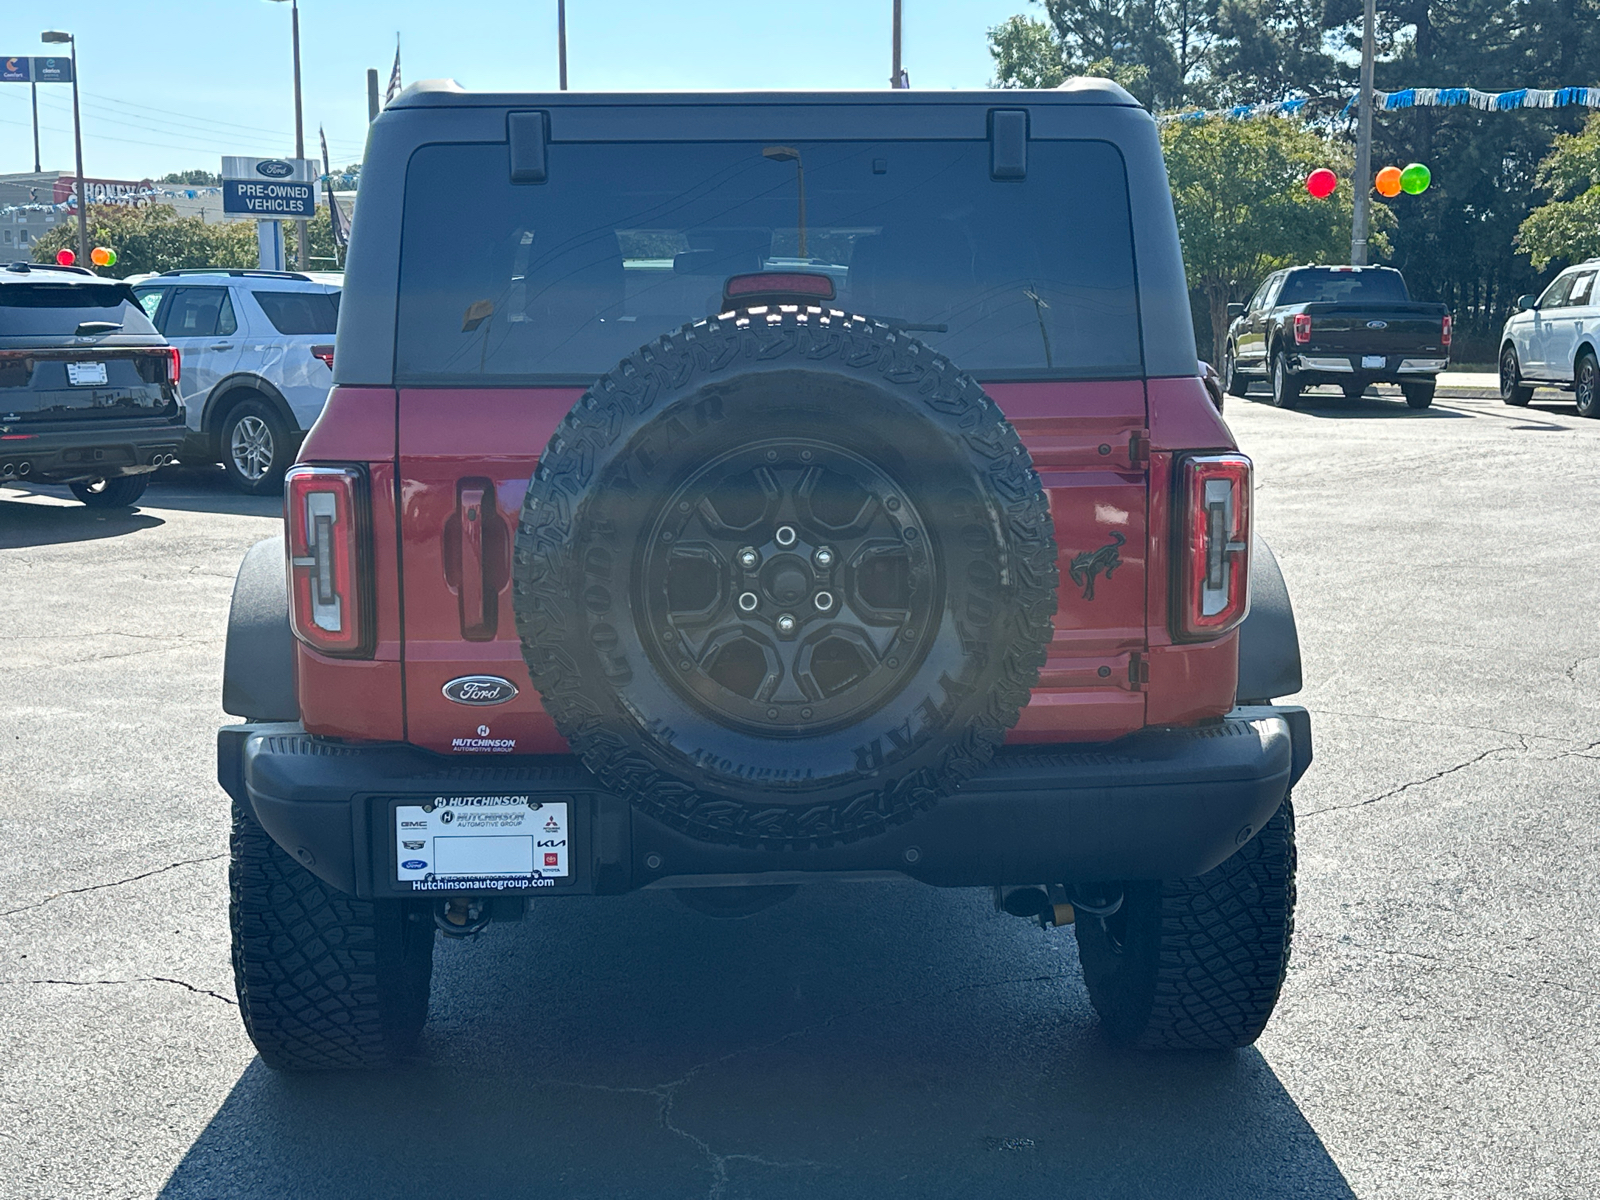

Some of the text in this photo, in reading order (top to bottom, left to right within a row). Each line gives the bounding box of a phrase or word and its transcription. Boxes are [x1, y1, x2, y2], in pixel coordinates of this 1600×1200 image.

[266, 164, 287, 175] Ford
[238, 184, 309, 199] PRE-OWNED
[245, 198, 304, 212] VEHICLES
[460, 682, 500, 699] Ford
[451, 738, 516, 747] HUTCHINSON
[448, 796, 529, 807] HUTCHINSON
[457, 812, 526, 821] HUTCHINSON
[537, 839, 566, 847] KIA
[405, 861, 423, 869] Ford
[412, 879, 555, 891] Hutchinsonautogroup.com
